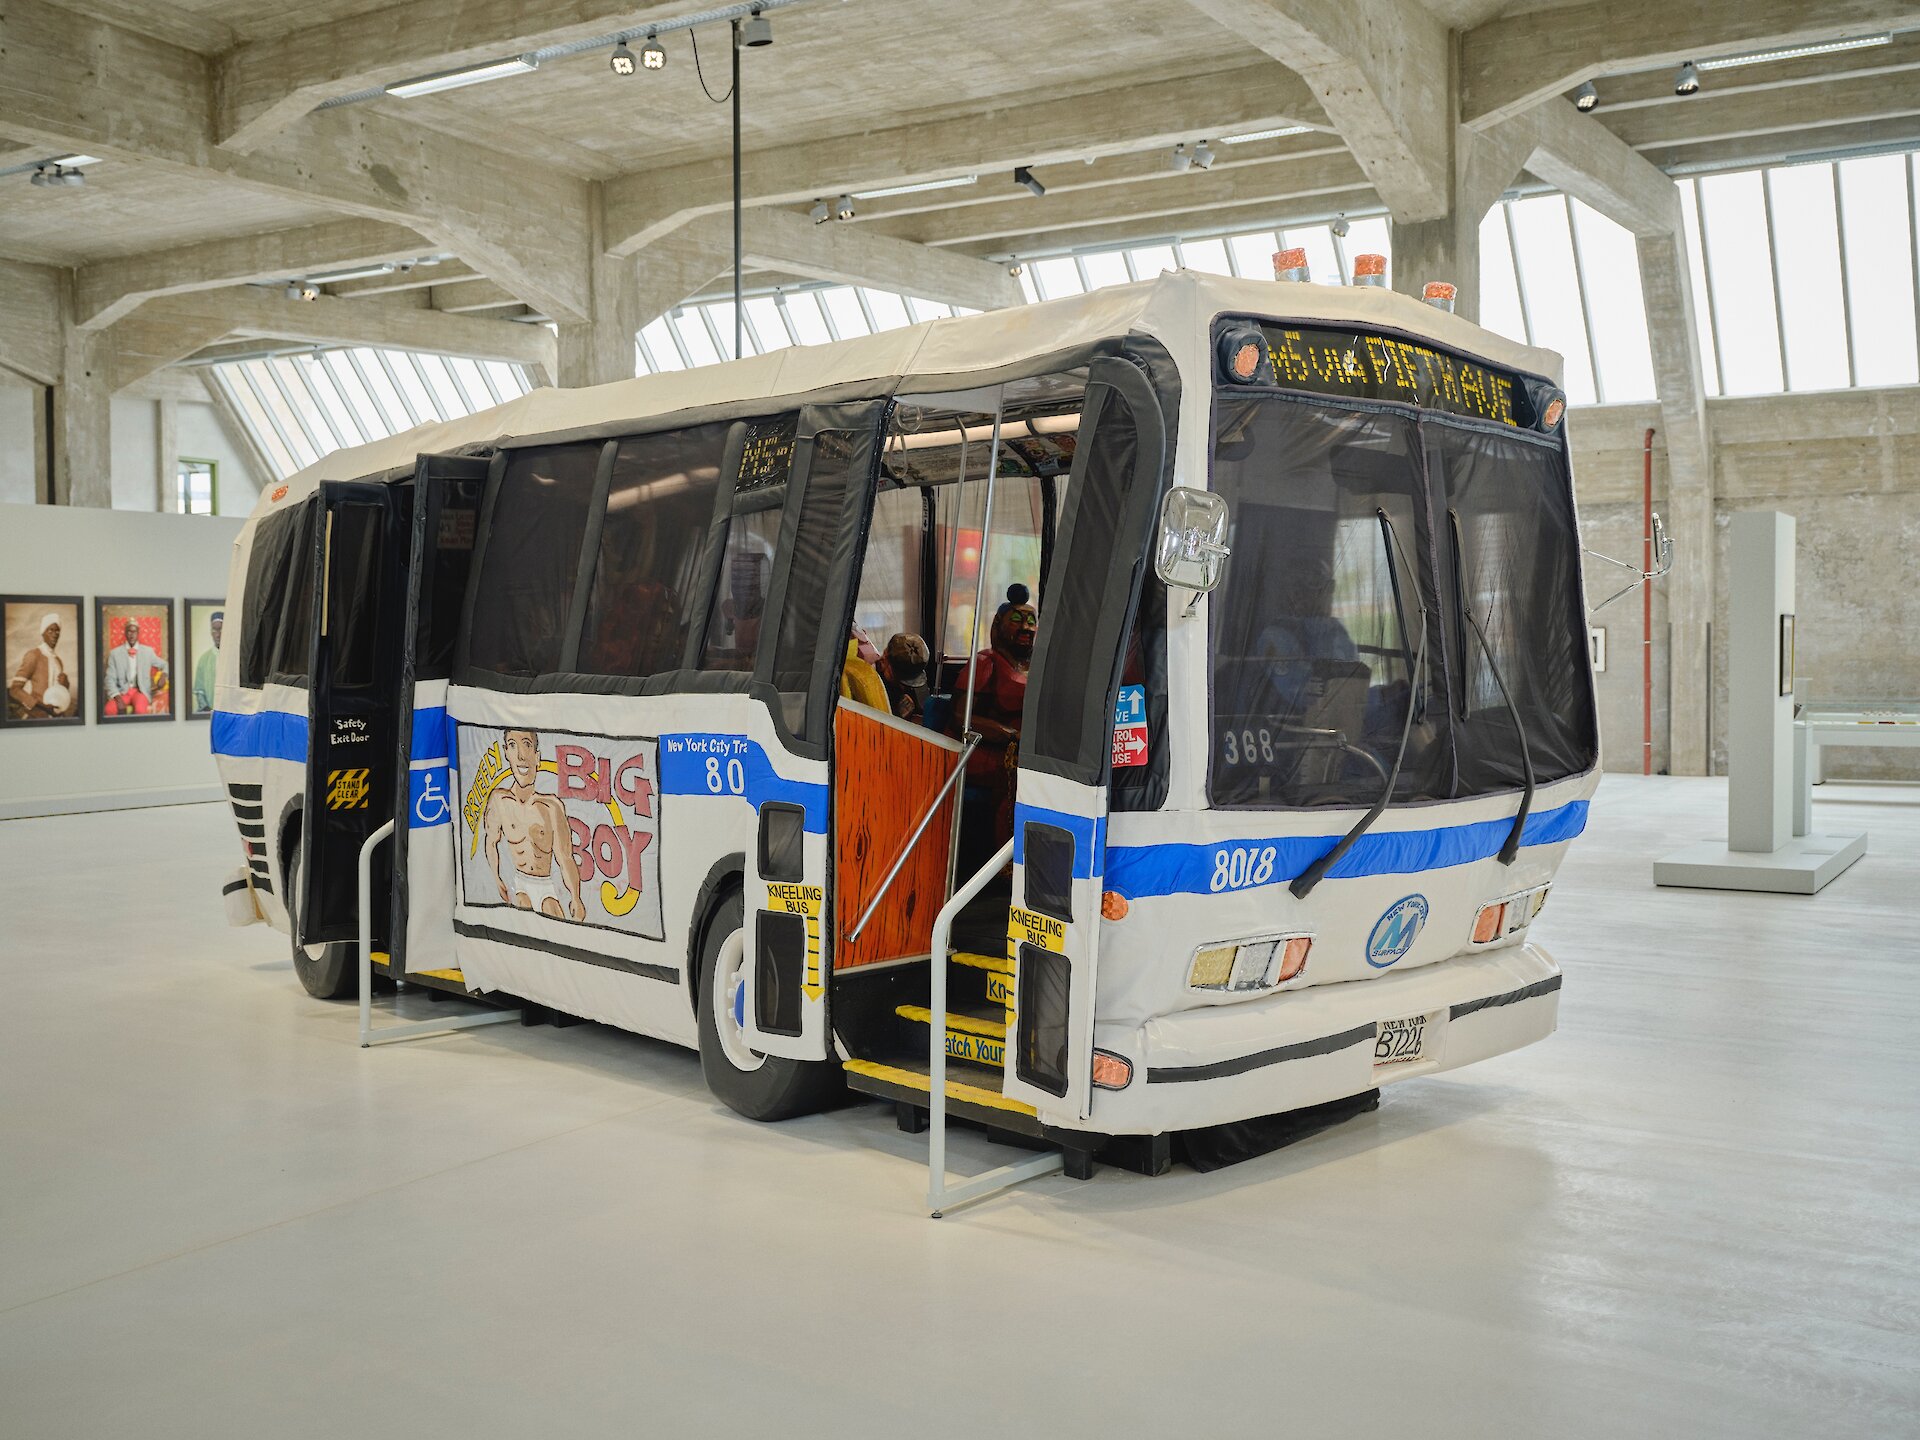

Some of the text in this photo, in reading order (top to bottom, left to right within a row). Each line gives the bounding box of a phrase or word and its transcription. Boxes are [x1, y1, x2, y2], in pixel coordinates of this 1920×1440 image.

[1460, 364, 1517, 427] AVE
[330, 731, 370, 745] Exit Door
[335, 718, 367, 731] Safety
[667, 739, 683, 753] New
[685, 737, 708, 753] York
[709, 738, 731, 757] City
[1225, 728, 1274, 765] 368
[337, 779, 360, 790] STAND
[463, 740, 503, 834] BRIEFLY
[555, 745, 655, 818] BIG
[705, 756, 745, 795] 80
[336, 789, 359, 799] CLEAR
[567, 816, 653, 893] BOY
[1210, 846, 1277, 893] 8018
[767, 885, 822, 901] KNEELING
[786, 900, 809, 914] BUS
[1010, 908, 1062, 938] KNEELING
[1386, 903, 1405, 922] NEW
[1027, 929, 1047, 949] BUS
[945, 1032, 1005, 1064] atch Your
[1374, 1026, 1424, 1059] B7226
